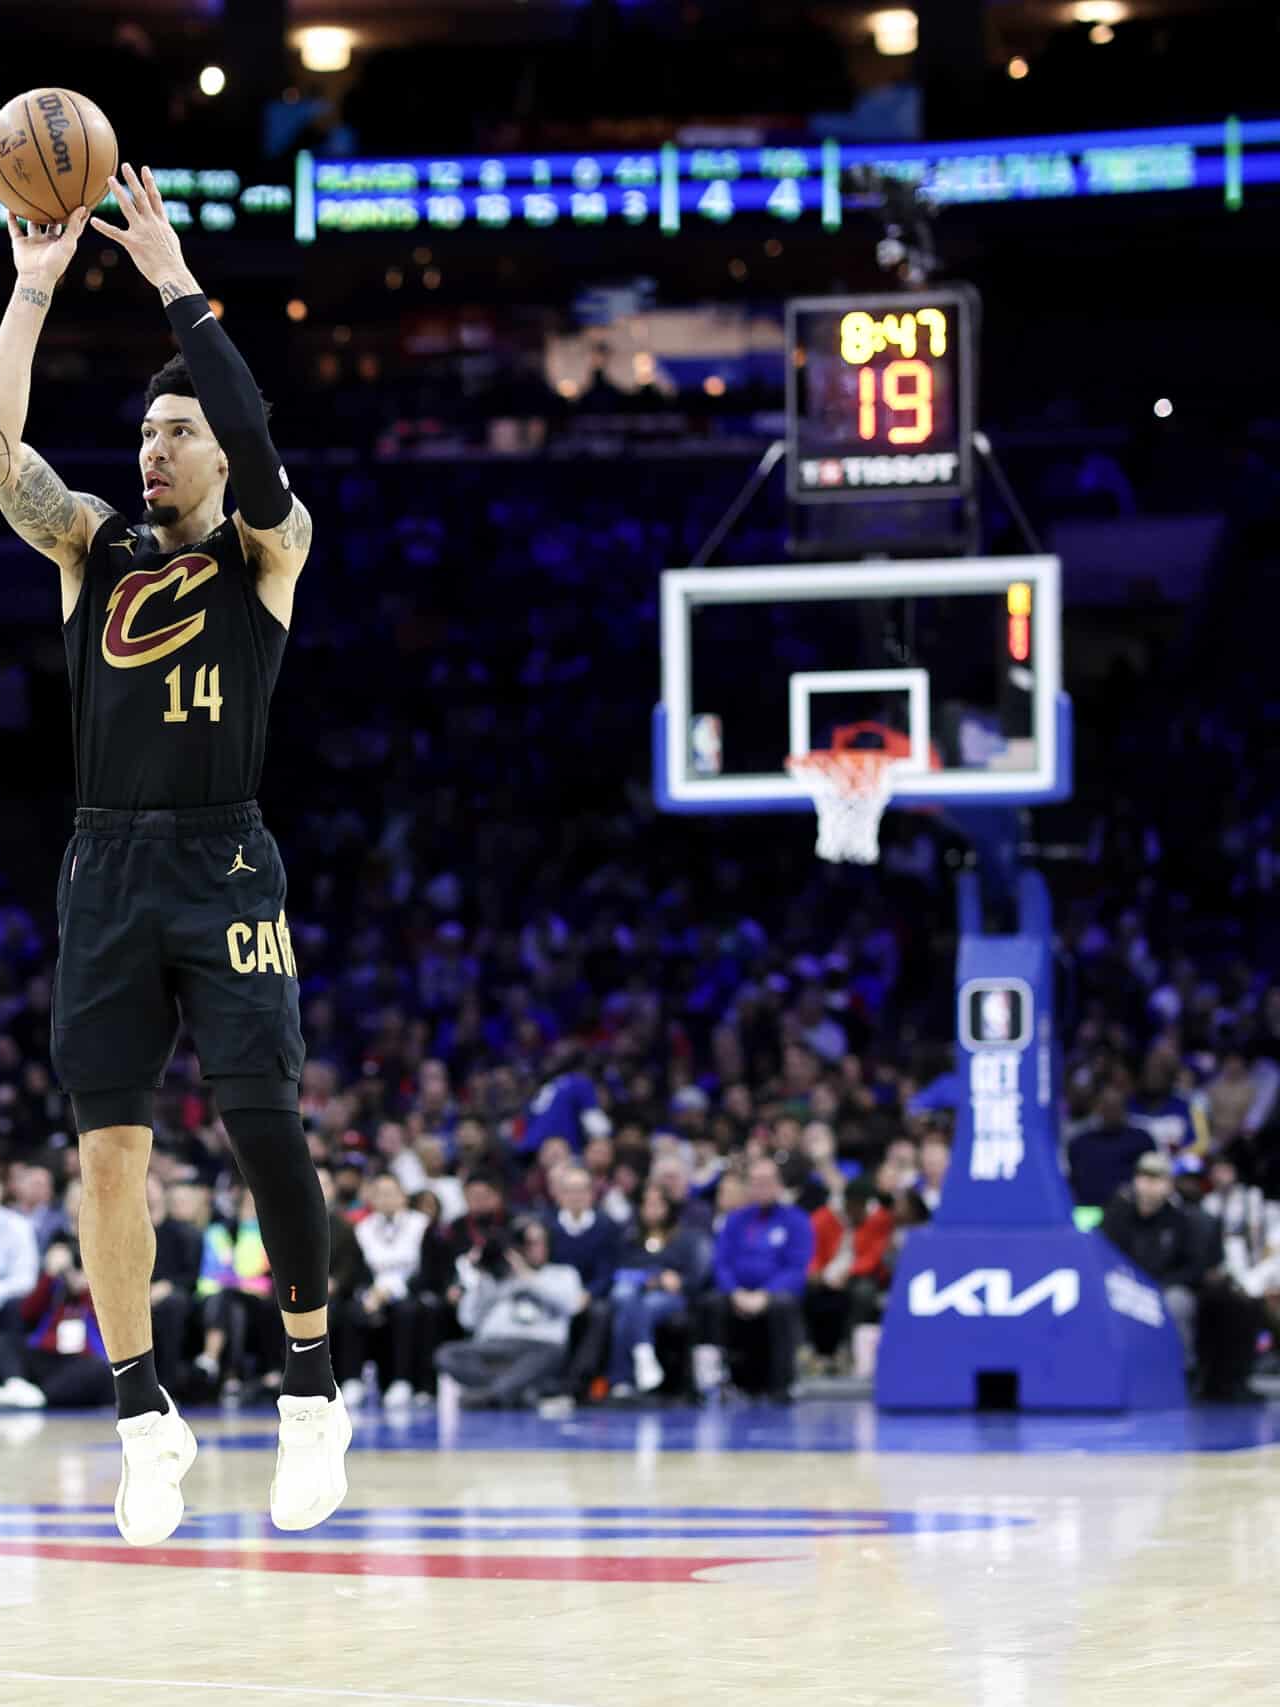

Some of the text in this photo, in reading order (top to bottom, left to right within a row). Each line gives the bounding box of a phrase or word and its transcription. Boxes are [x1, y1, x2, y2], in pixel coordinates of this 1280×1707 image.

[37, 92, 72, 175] Wilson
[697, 178, 803, 222] 4 4
[840, 308, 947, 365] 8:47
[858, 359, 933, 445] 19
[163, 663, 223, 723] 14
[908, 1267, 1081, 1317] KIA
